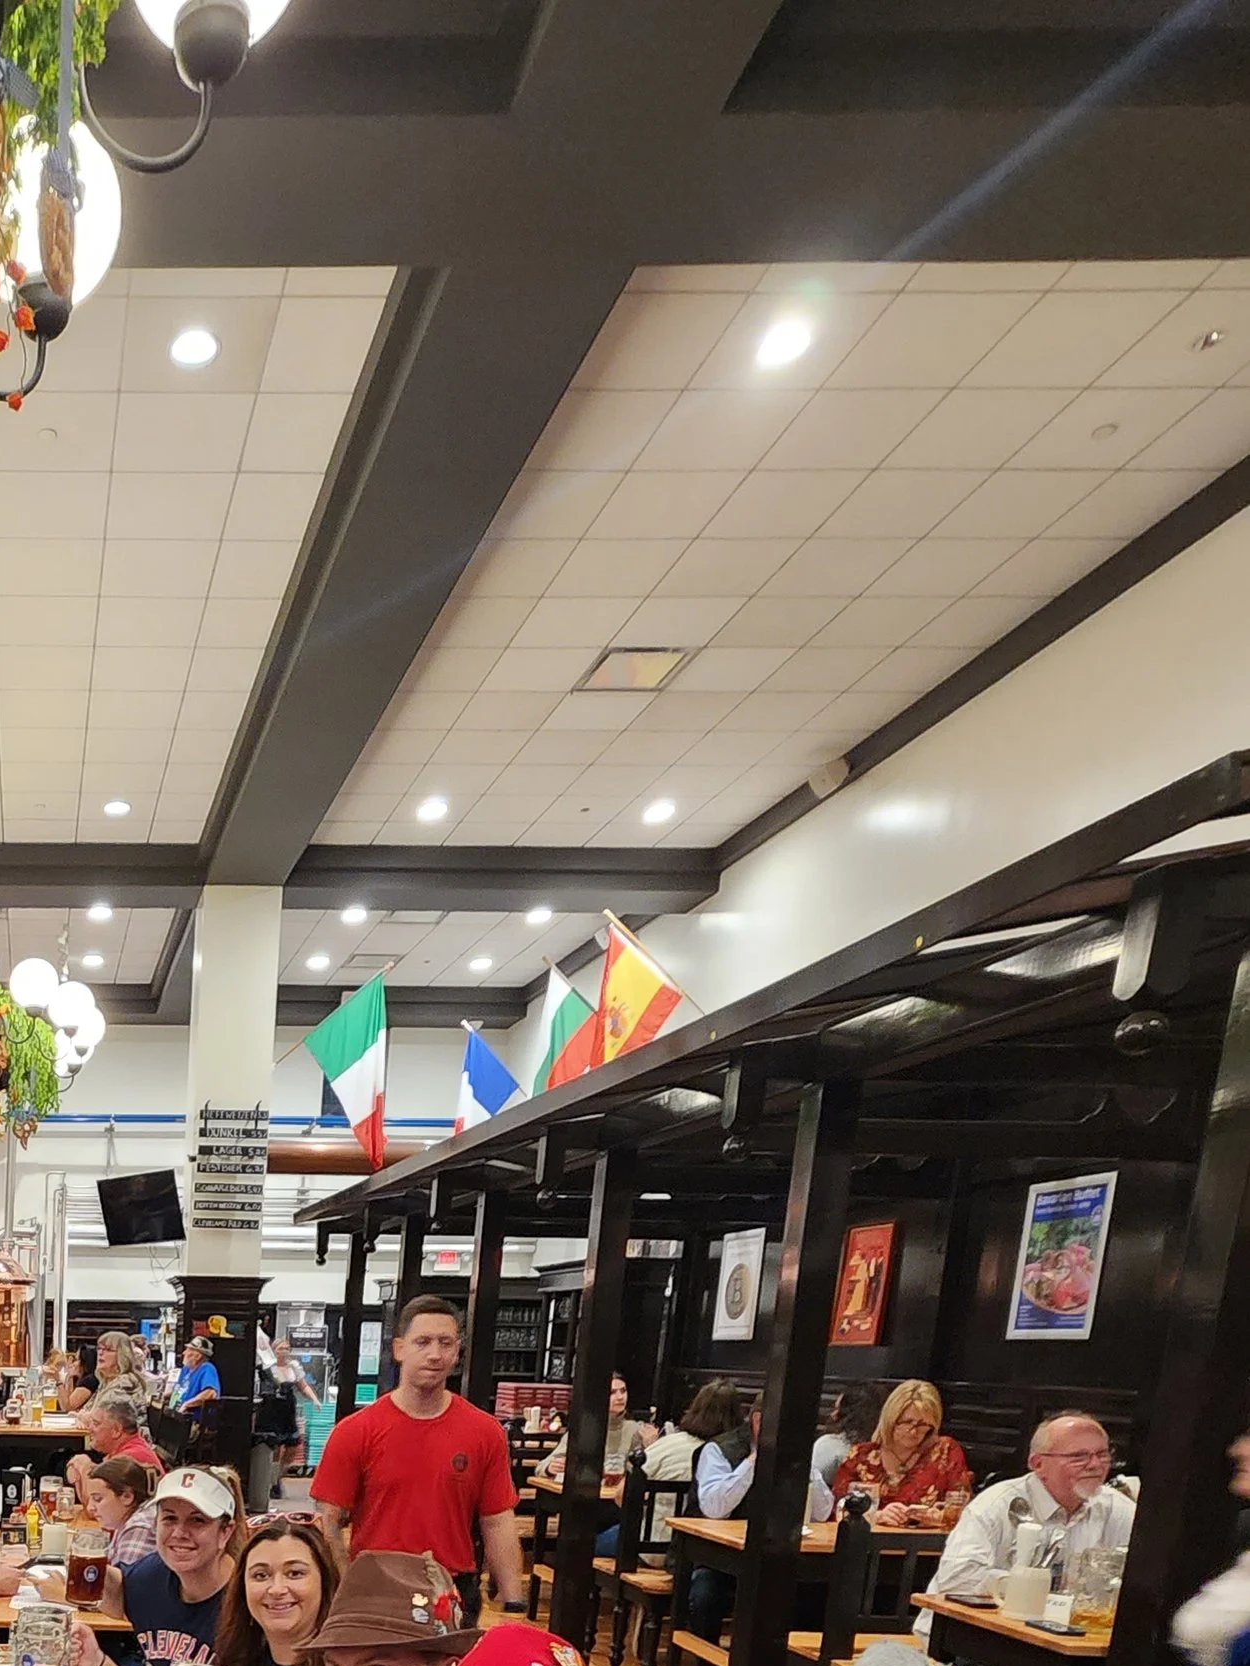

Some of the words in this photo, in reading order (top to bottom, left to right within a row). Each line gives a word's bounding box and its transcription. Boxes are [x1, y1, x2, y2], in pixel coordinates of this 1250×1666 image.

[206, 1127, 247, 1138] DUNKEL
[212, 1146, 243, 1156] LAGER
[181, 1473, 196, 1488] C
